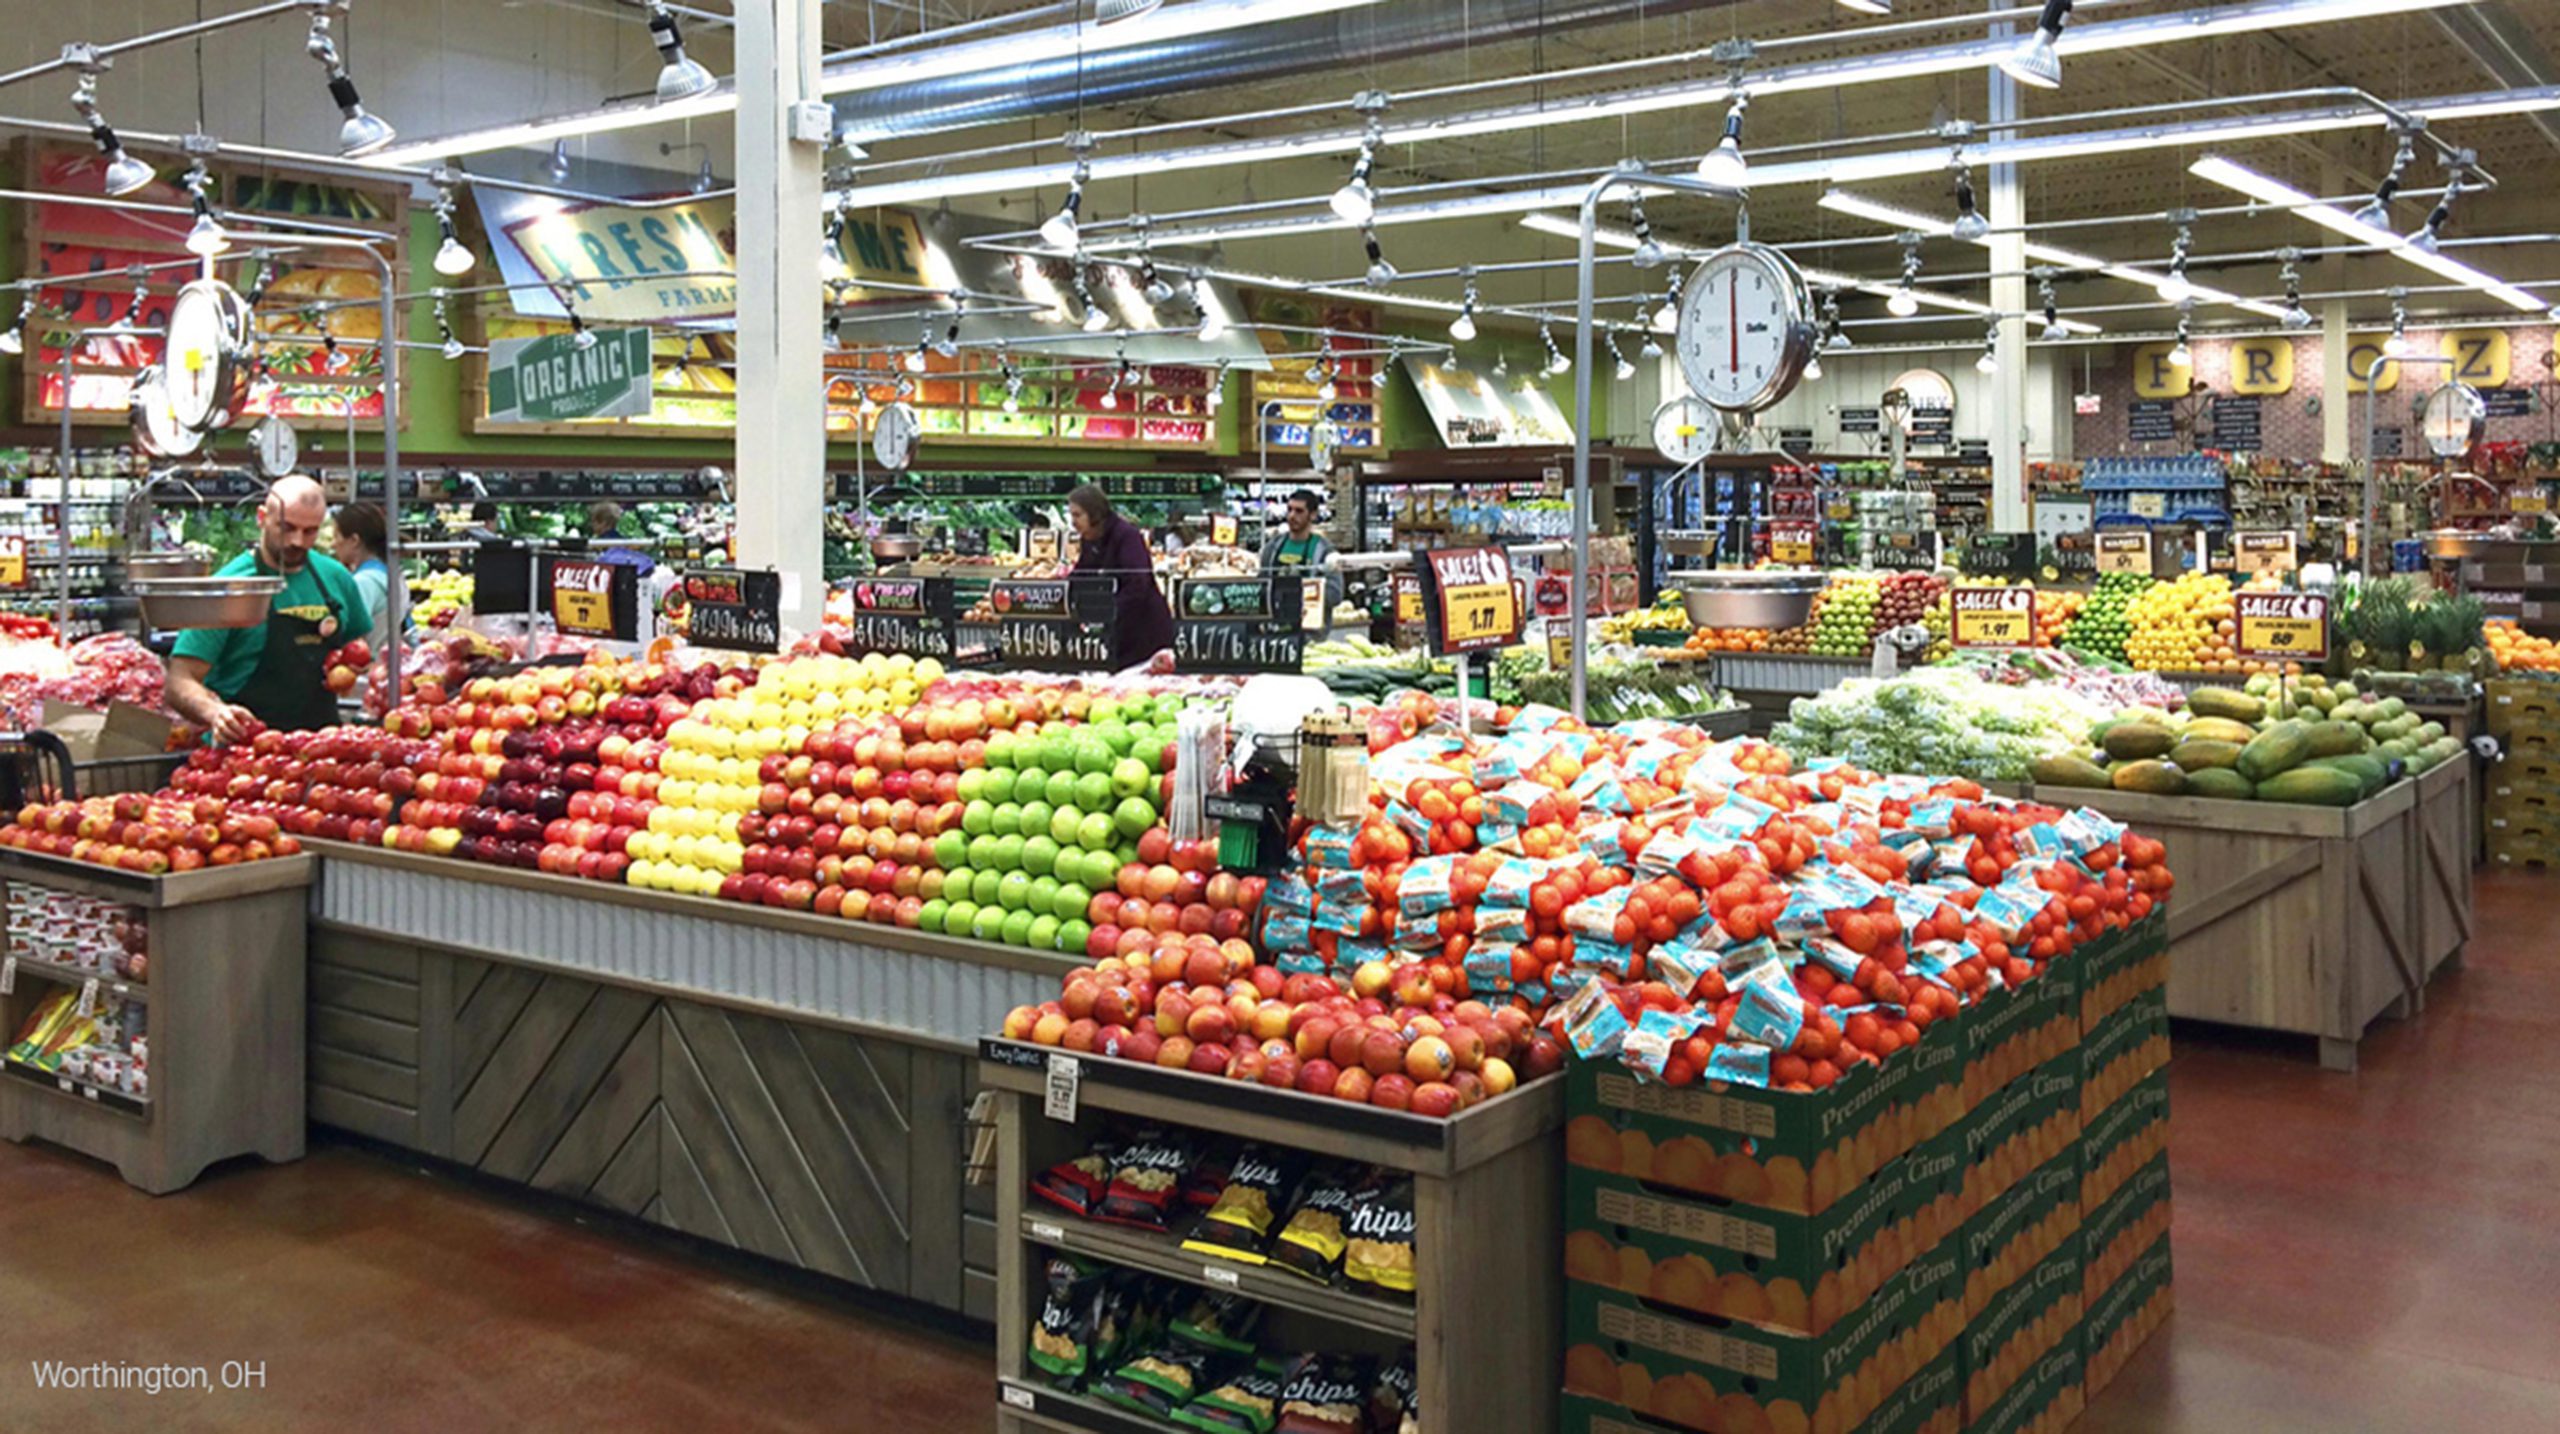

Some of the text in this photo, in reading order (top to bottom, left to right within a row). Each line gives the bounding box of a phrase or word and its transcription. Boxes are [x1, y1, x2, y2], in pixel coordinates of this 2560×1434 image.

[522, 340, 624, 403] ORGANIC
[1955, 592, 2001, 610] SALE!
[2241, 597, 2292, 616] SALE!
[1821, 1062, 1909, 1137] Premium
[1912, 1042, 1957, 1072] Citrus
[1965, 1073, 2075, 1152] Premium Citrus
[1118, 1144, 1184, 1168] chips
[1230, 1153, 1280, 1185] hips
[1350, 1203, 1418, 1237] hips
[1822, 1175, 1903, 1259] Premium
[1907, 1152, 1957, 1184] Citrus
[1969, 1164, 2075, 1257] Premium Citrus
[1822, 1287, 1905, 1378] Premium
[1908, 1257, 1957, 1295] Citrus
[1972, 1255, 2077, 1358] Premium Citrus
[1283, 1376, 1360, 1402] chips
[1908, 1362, 1955, 1400] Citrus
